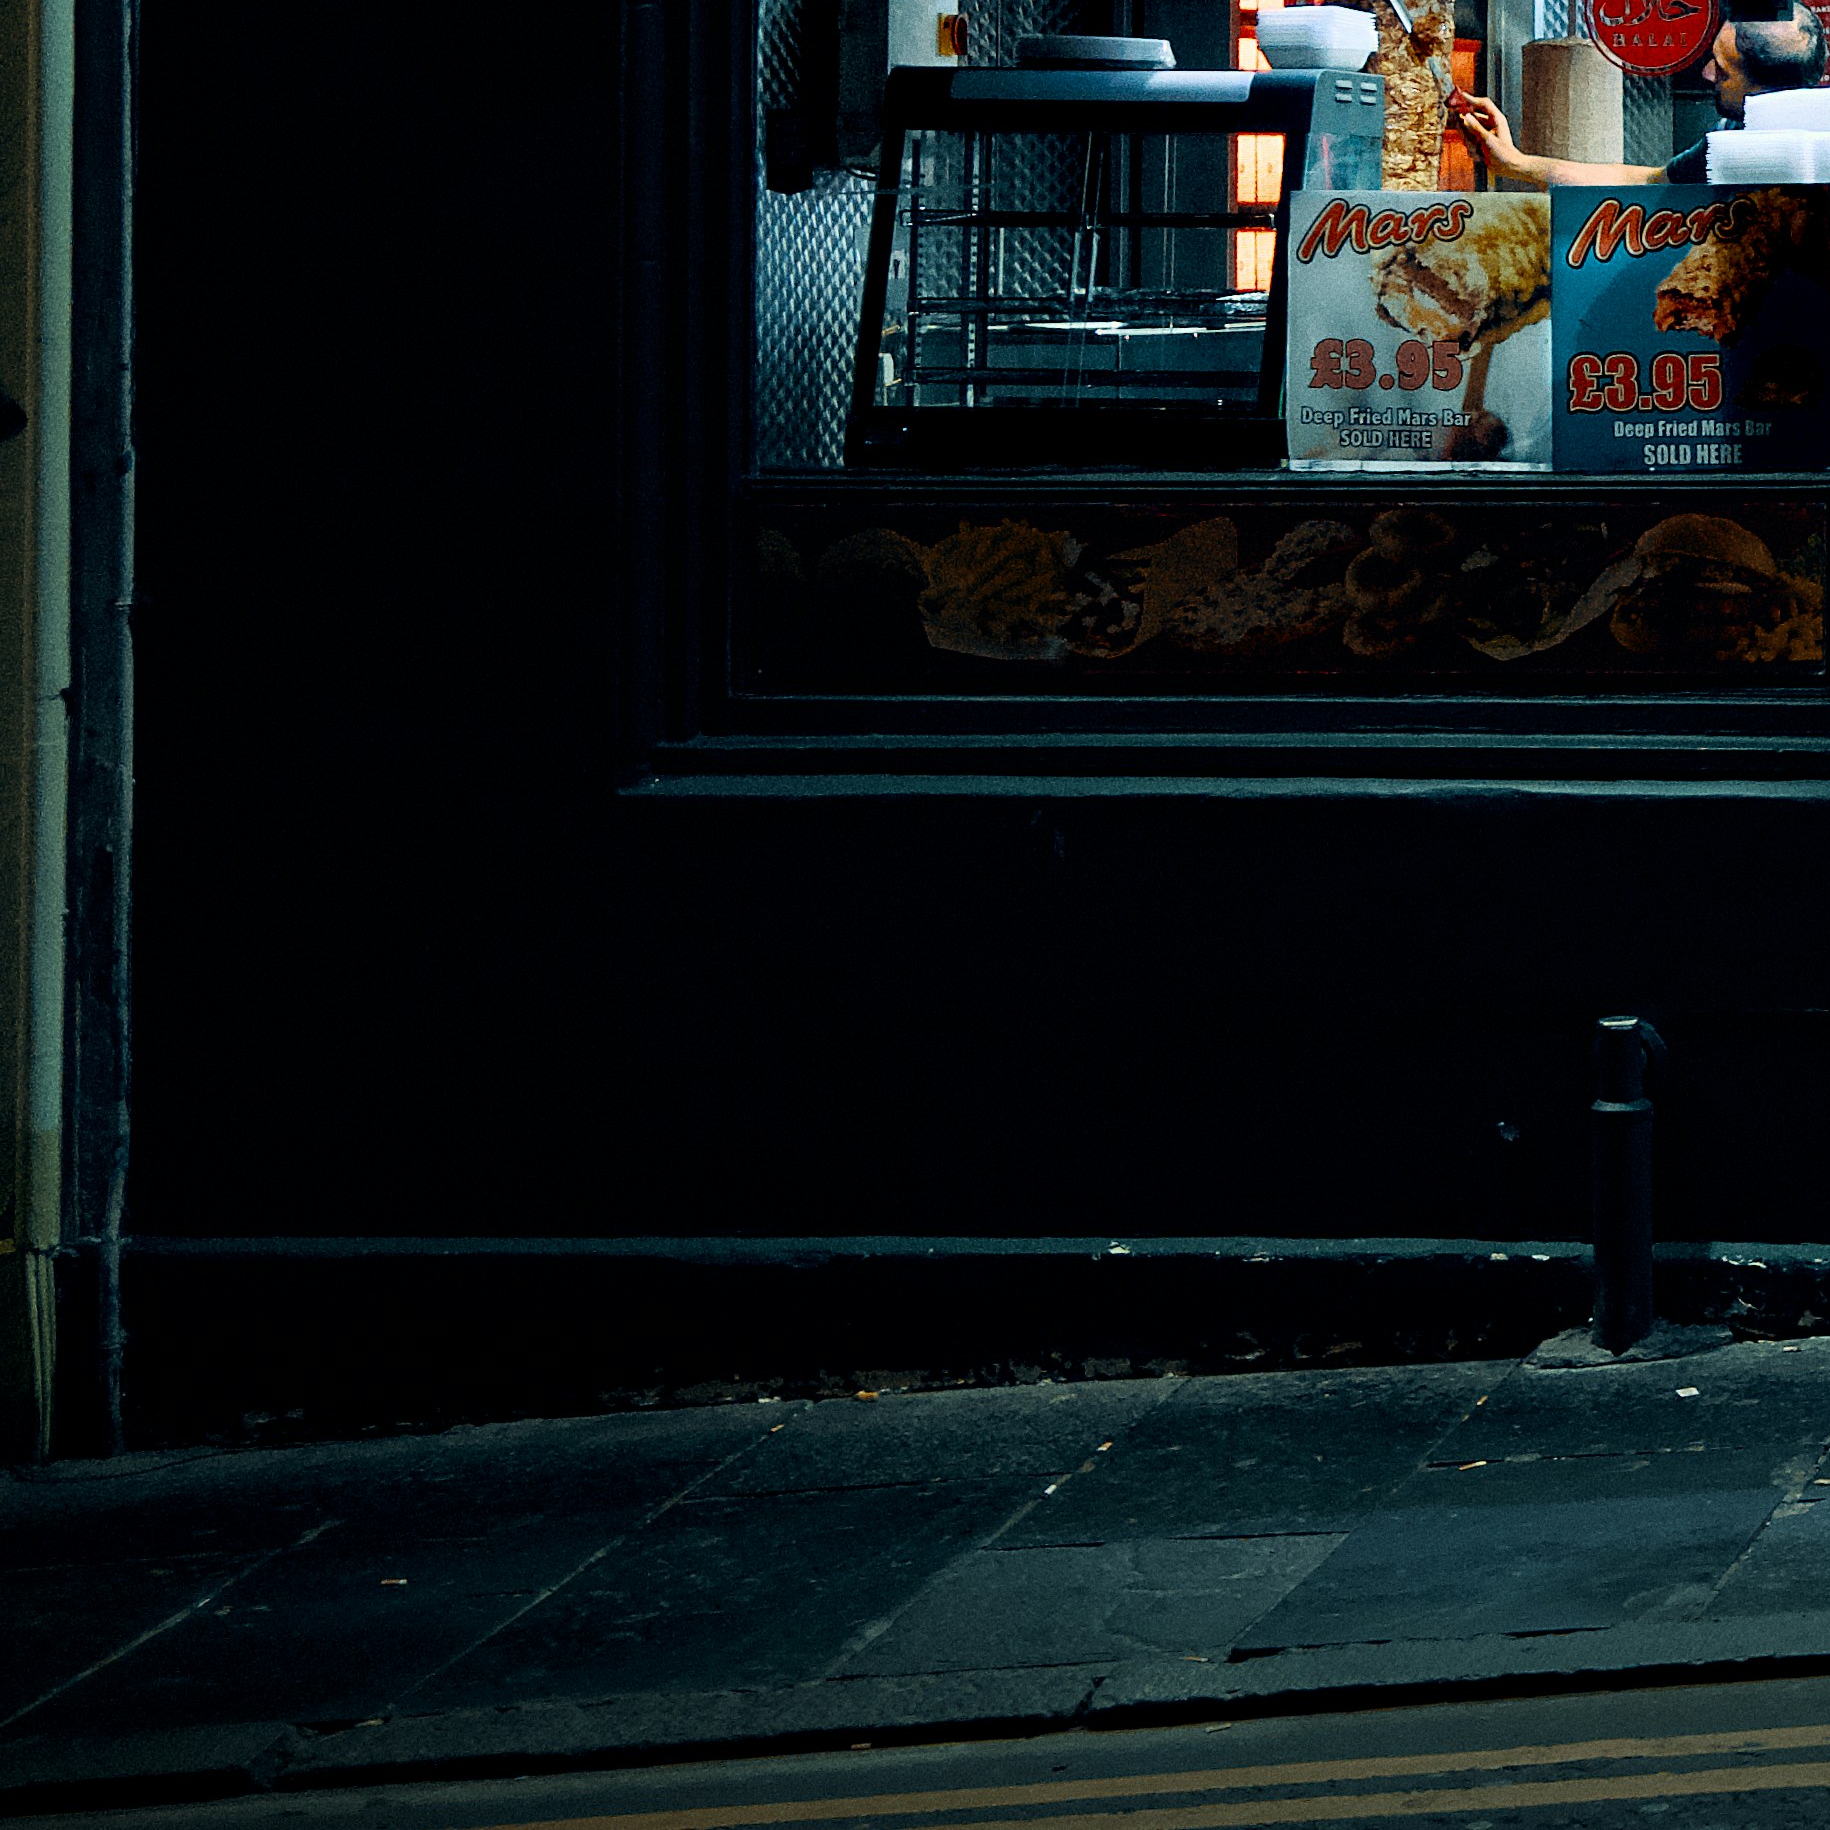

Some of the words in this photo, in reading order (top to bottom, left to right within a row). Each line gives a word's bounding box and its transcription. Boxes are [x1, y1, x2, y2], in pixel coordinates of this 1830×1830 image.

[1297, 198, 1474, 262] Mars
[1568, 197, 1756, 268] Mars
[1309, 338, 1465, 392] £3.95
[1568, 351, 1724, 414] £3.95
[1302, 406, 1344, 428] Deep
[1349, 406, 1393, 427] Fried
[1398, 408, 1437, 427] Mars
[1441, 409, 1472, 428] Bar
[1613, 420, 1654, 441] Deep
[1658, 421, 1697, 439] Fried
[1701, 421, 1740, 439] Mars
[1745, 421, 1773, 439] Bar
[1340, 428, 1383, 448] SOLD
[1387, 430, 1432, 448] HERE
[1643, 444, 1691, 466] SOLD
[1696, 444, 1743, 466] HERE
